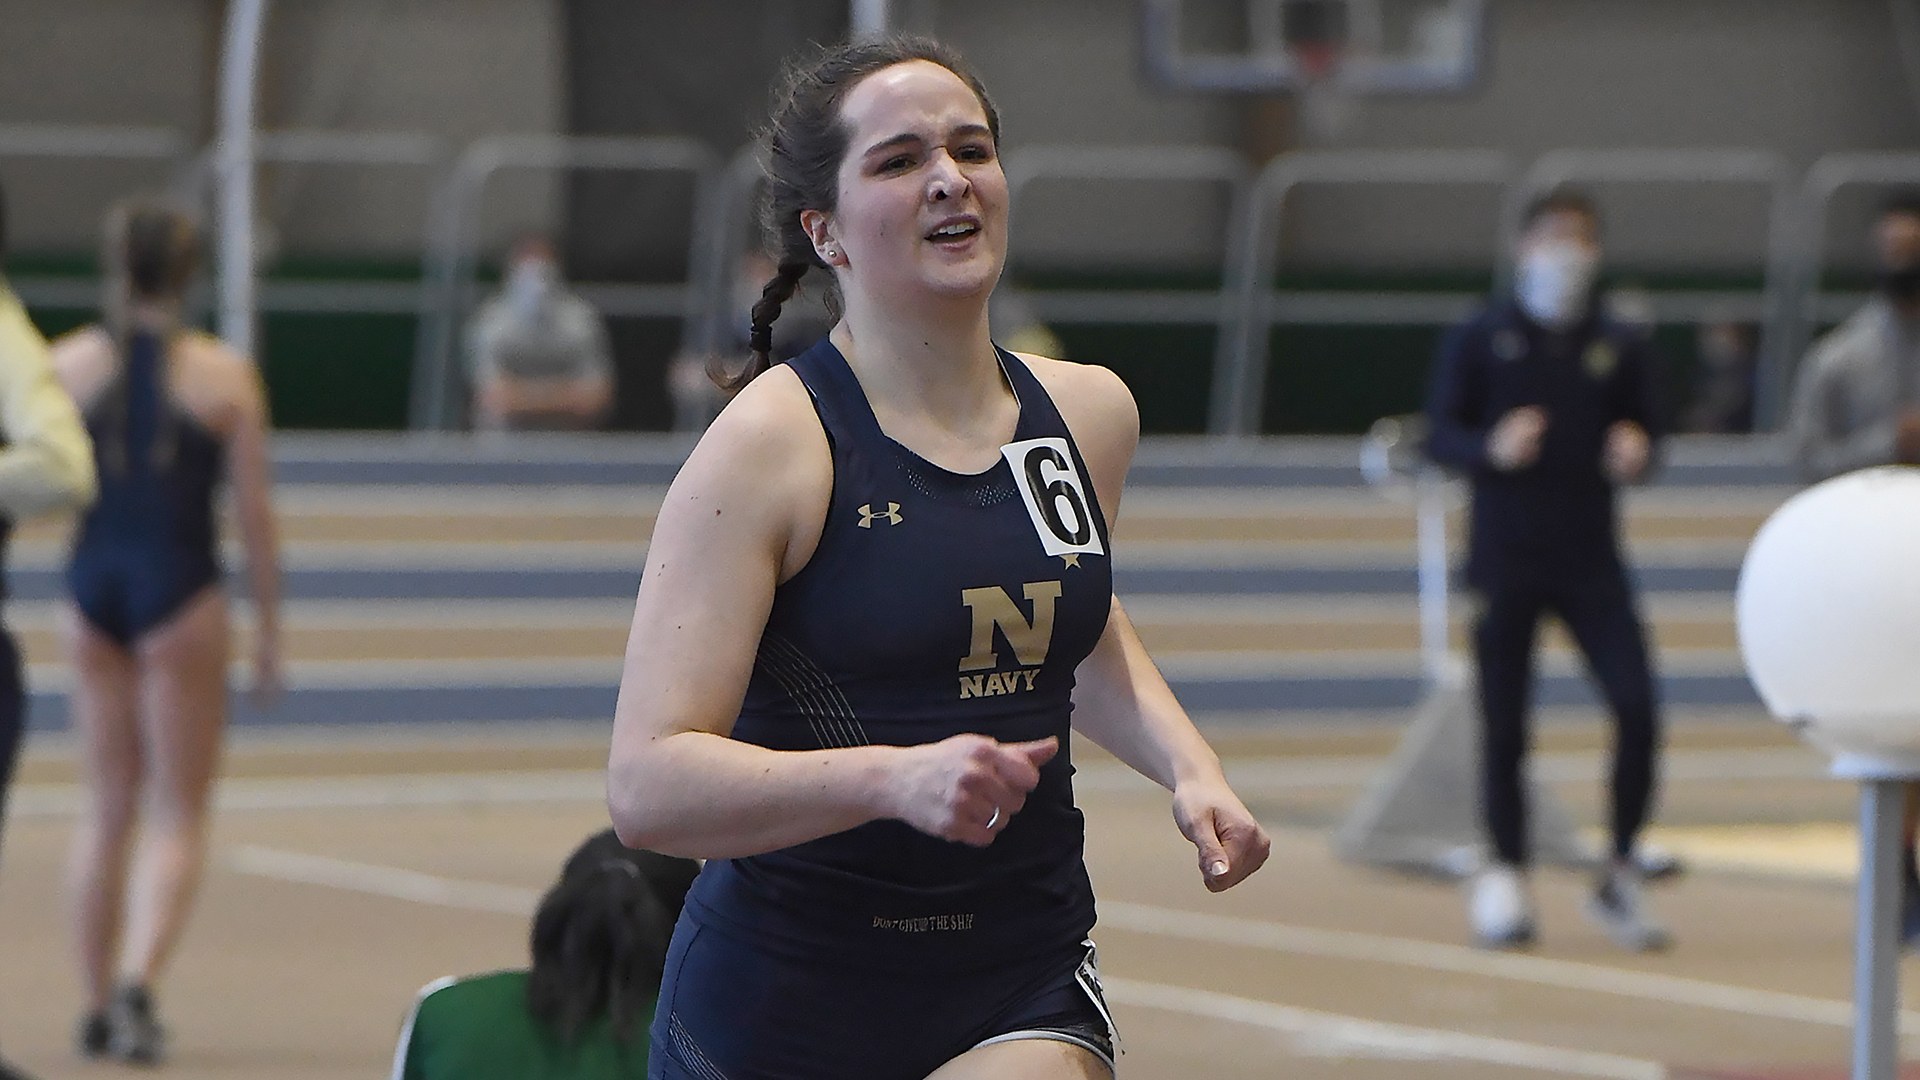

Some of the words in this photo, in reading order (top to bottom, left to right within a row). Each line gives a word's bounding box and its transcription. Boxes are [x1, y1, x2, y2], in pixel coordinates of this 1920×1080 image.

[1024, 445, 1091, 546] 6
[958, 580, 1062, 672] N
[959, 668, 1041, 699] NAVY
[929, 914, 949, 931] THE
